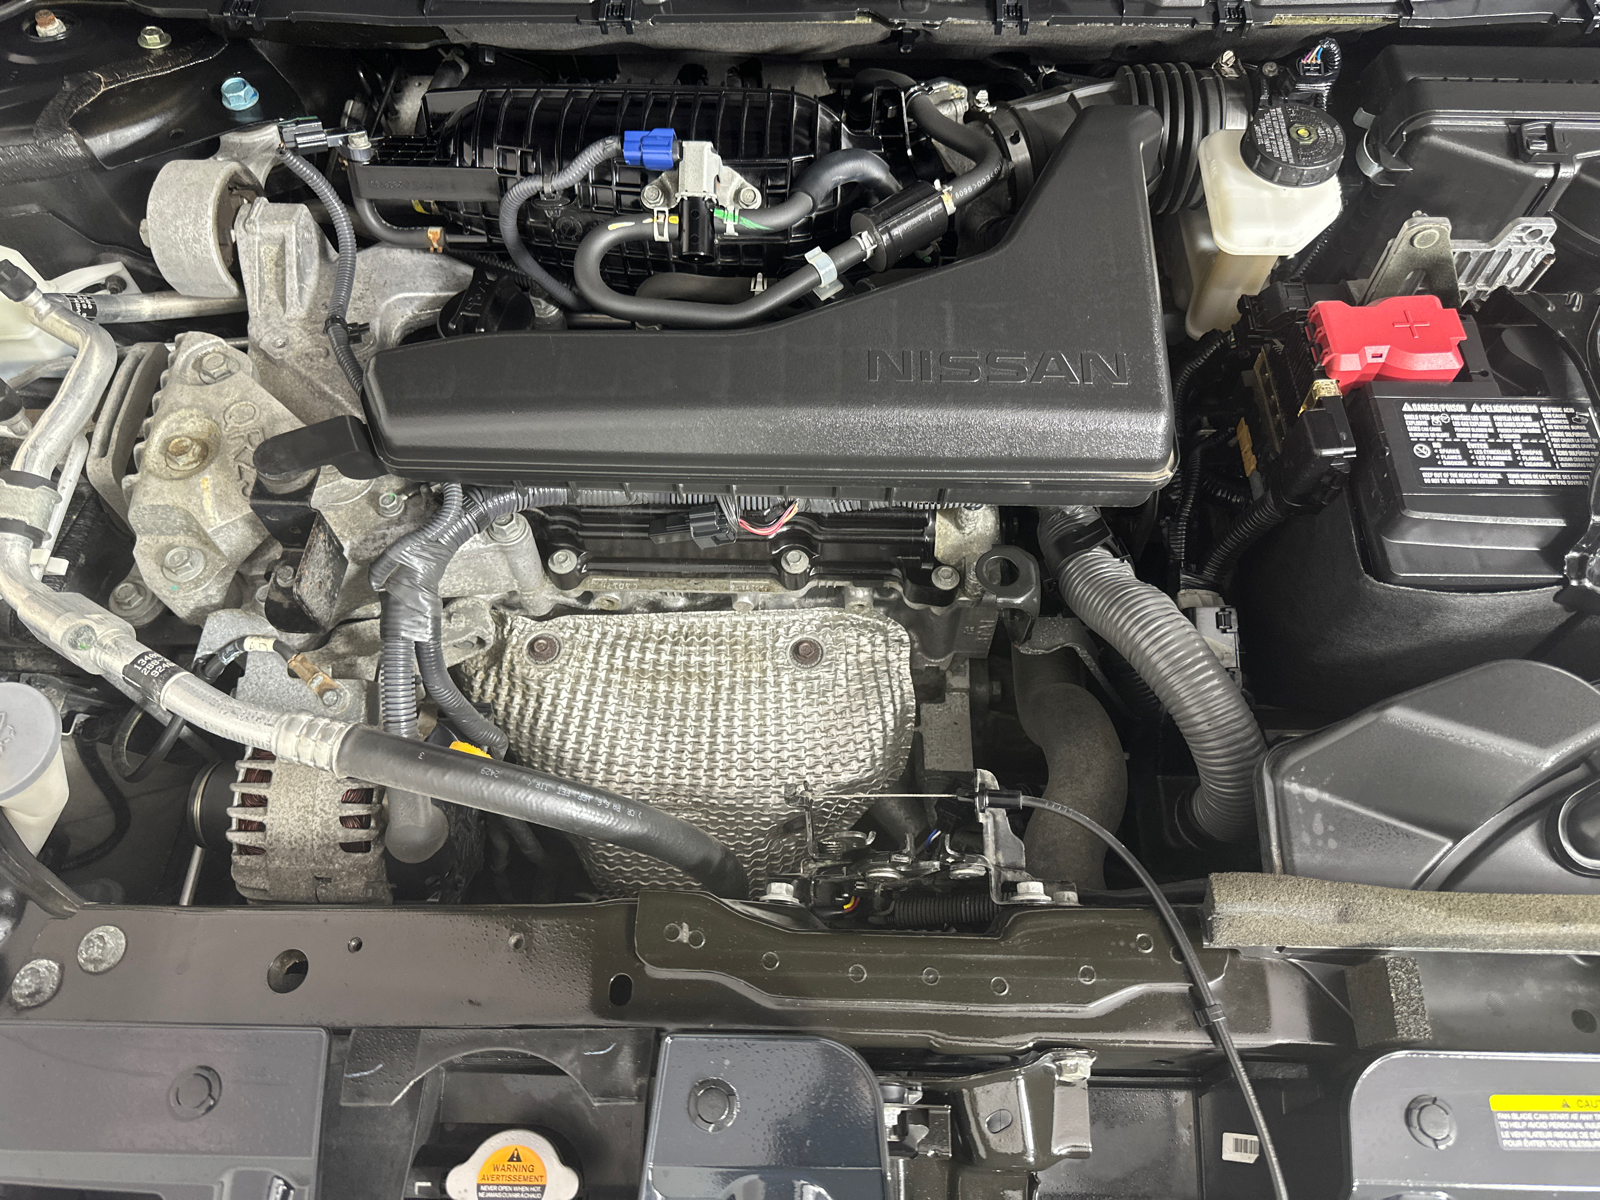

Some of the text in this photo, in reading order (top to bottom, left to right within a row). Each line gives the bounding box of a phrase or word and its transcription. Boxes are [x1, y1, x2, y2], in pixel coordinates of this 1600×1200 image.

[868, 350, 1129, 385] NISSAN
[1412, 403, 1467, 412] DANGER/POISON
[1480, 404, 1538, 414] PELIGRO/VENENO
[480, 767, 500, 778] 2429
[1548, 1122, 1584, 1130] PERSONAL
[1510, 1131, 1552, 1139] VENTILATEUR
[1502, 1140, 1522, 1148] POUR
[1523, 1138, 1546, 1148] ÉVITER
[1546, 1140, 1568, 1148] TOUTE
[492, 1164, 534, 1172] WARNING
[481, 1174, 544, 1182] AVERTISSEMENT
